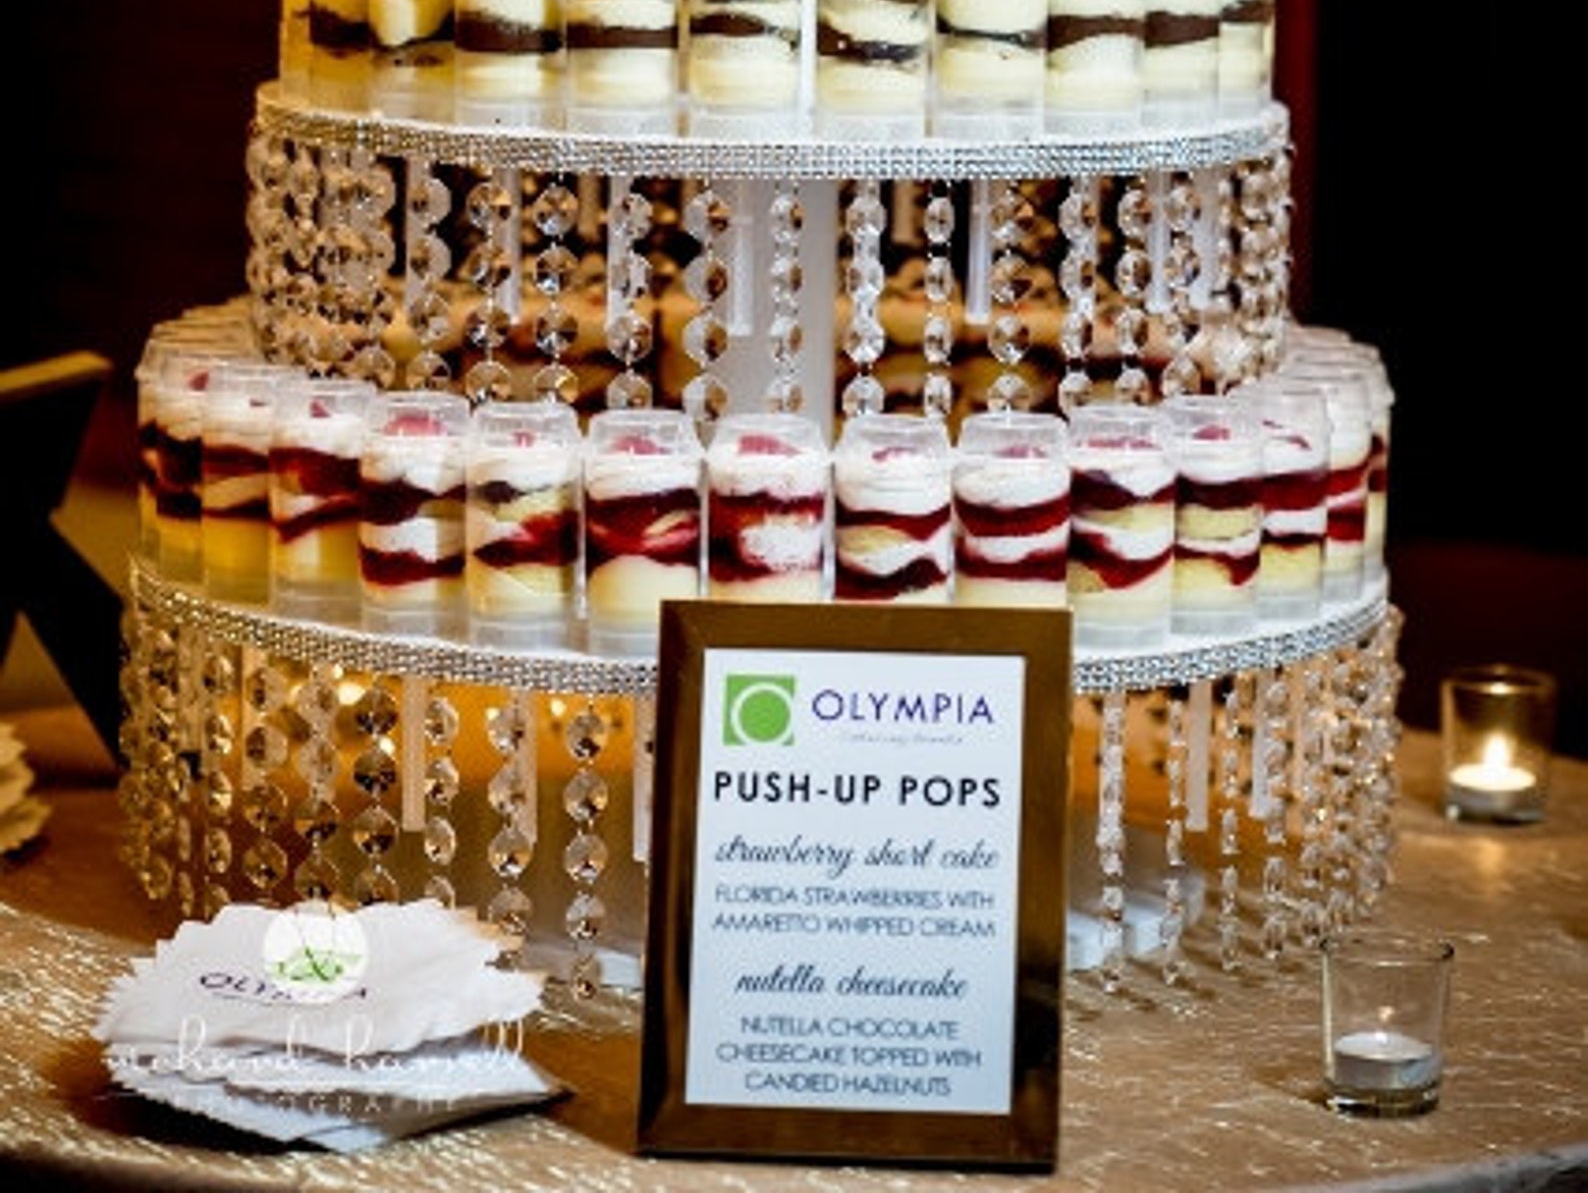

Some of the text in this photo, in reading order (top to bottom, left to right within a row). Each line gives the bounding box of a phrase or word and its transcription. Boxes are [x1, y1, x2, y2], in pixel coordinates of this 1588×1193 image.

[811, 689, 993, 724] OLYMPIA
[714, 771, 1000, 807] PUSH-UP POPS
[714, 834, 999, 880] strawberry short cake
[715, 884, 994, 909] FLORIDA STRAWBERRIES WITH
[712, 913, 996, 937] AMARETTO WHIPPED CREAM
[735, 964, 967, 999] nutella cheesecake
[741, 1015, 960, 1039] NUTELLA CHOCOLATE
[716, 1042, 981, 1067] CHEESECAKE TOPPED WITH
[745, 1071, 951, 1096] CANDIED HAZELNUTS
